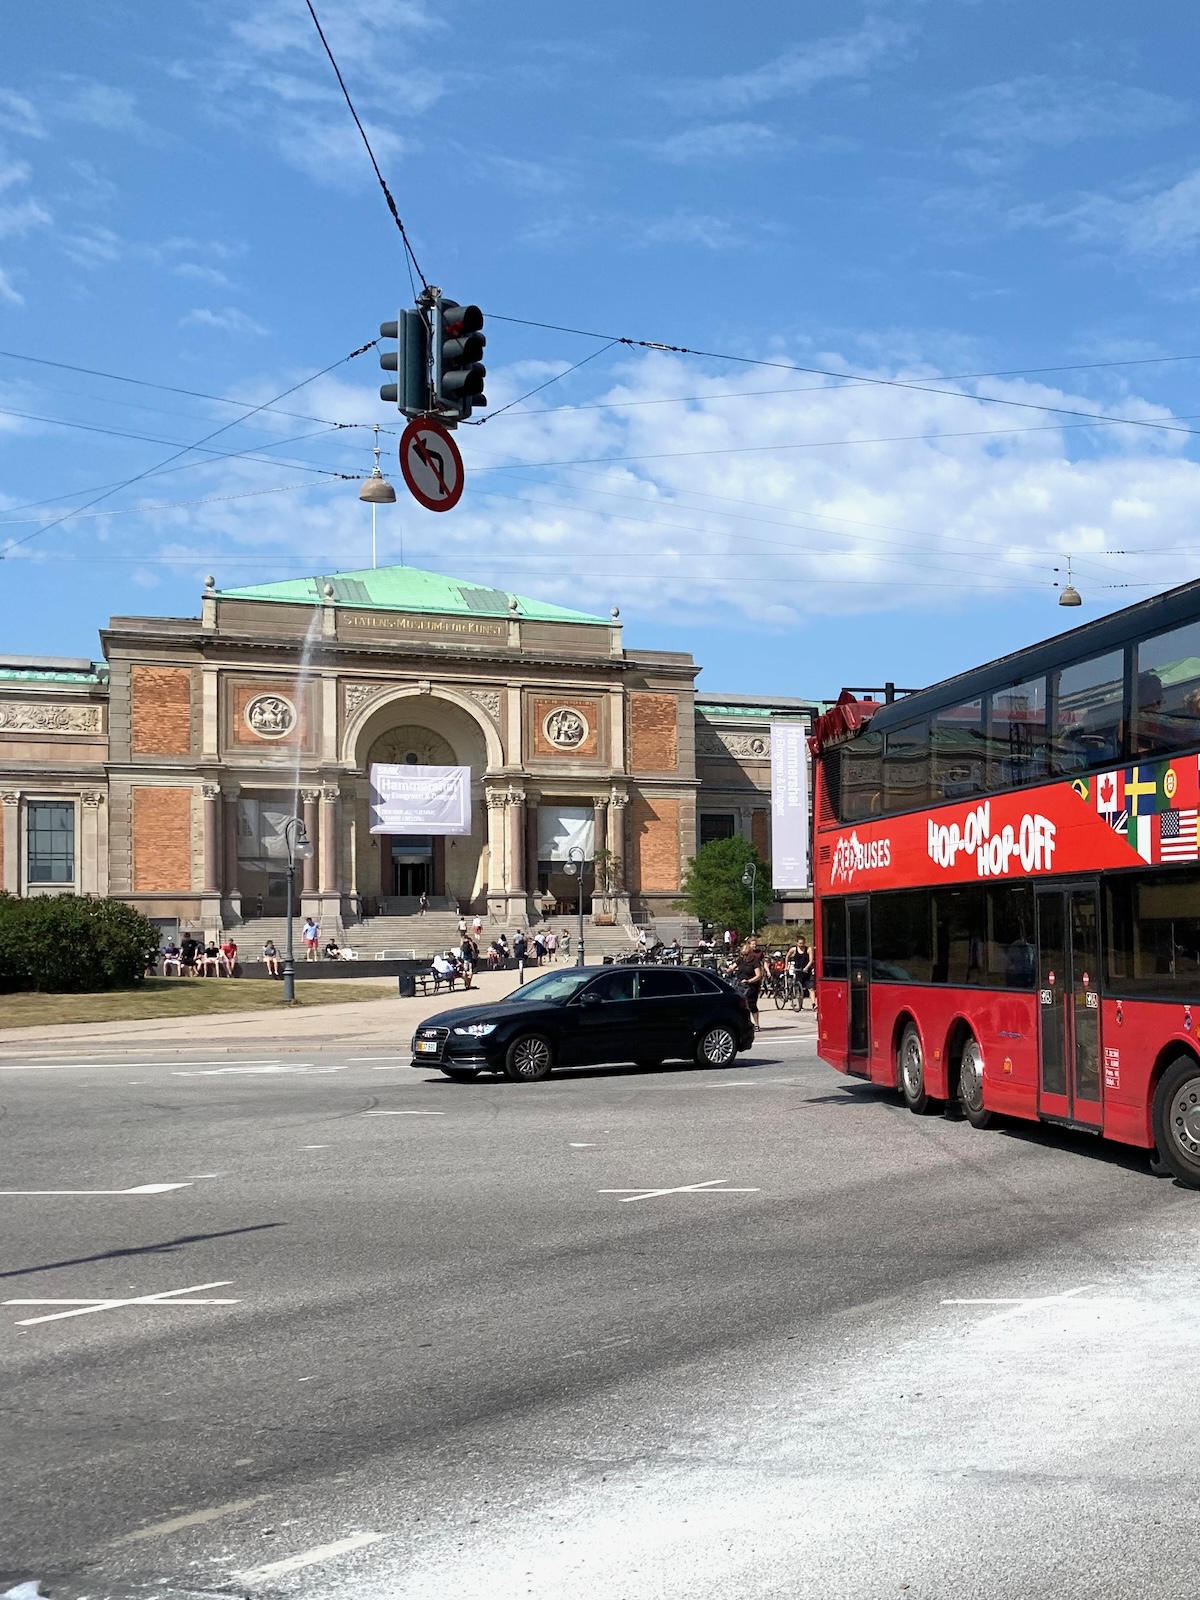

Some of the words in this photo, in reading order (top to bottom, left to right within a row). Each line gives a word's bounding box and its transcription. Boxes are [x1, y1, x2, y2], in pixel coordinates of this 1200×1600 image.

[467, 622, 503, 635] KUNST
[857, 838, 891, 870] BUSES
[928, 800, 990, 868] HOP-ON
[977, 813, 1056, 876] HOP-OFF
